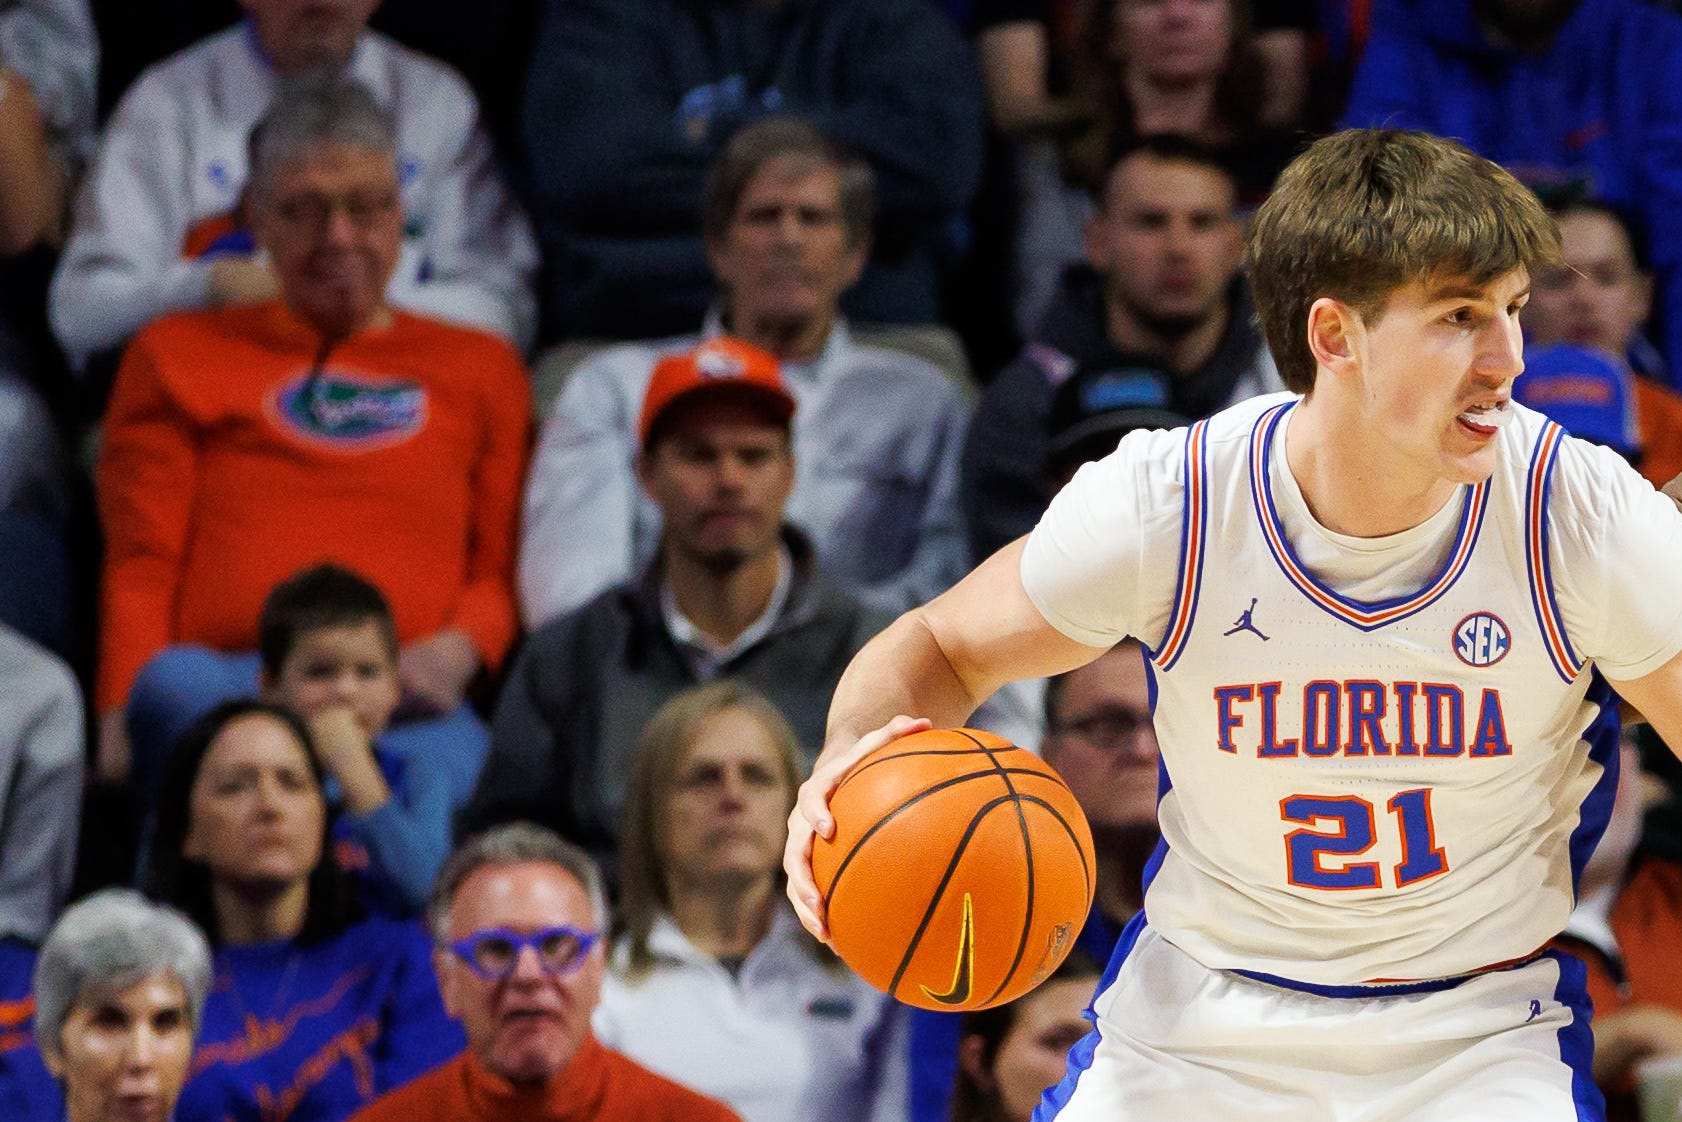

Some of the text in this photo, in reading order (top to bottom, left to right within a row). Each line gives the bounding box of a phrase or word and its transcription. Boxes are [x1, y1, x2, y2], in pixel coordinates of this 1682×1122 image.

[1456, 615, 1510, 665] SEC
[1213, 679, 1514, 759] FLORIDA
[1278, 787, 1450, 891] 21
